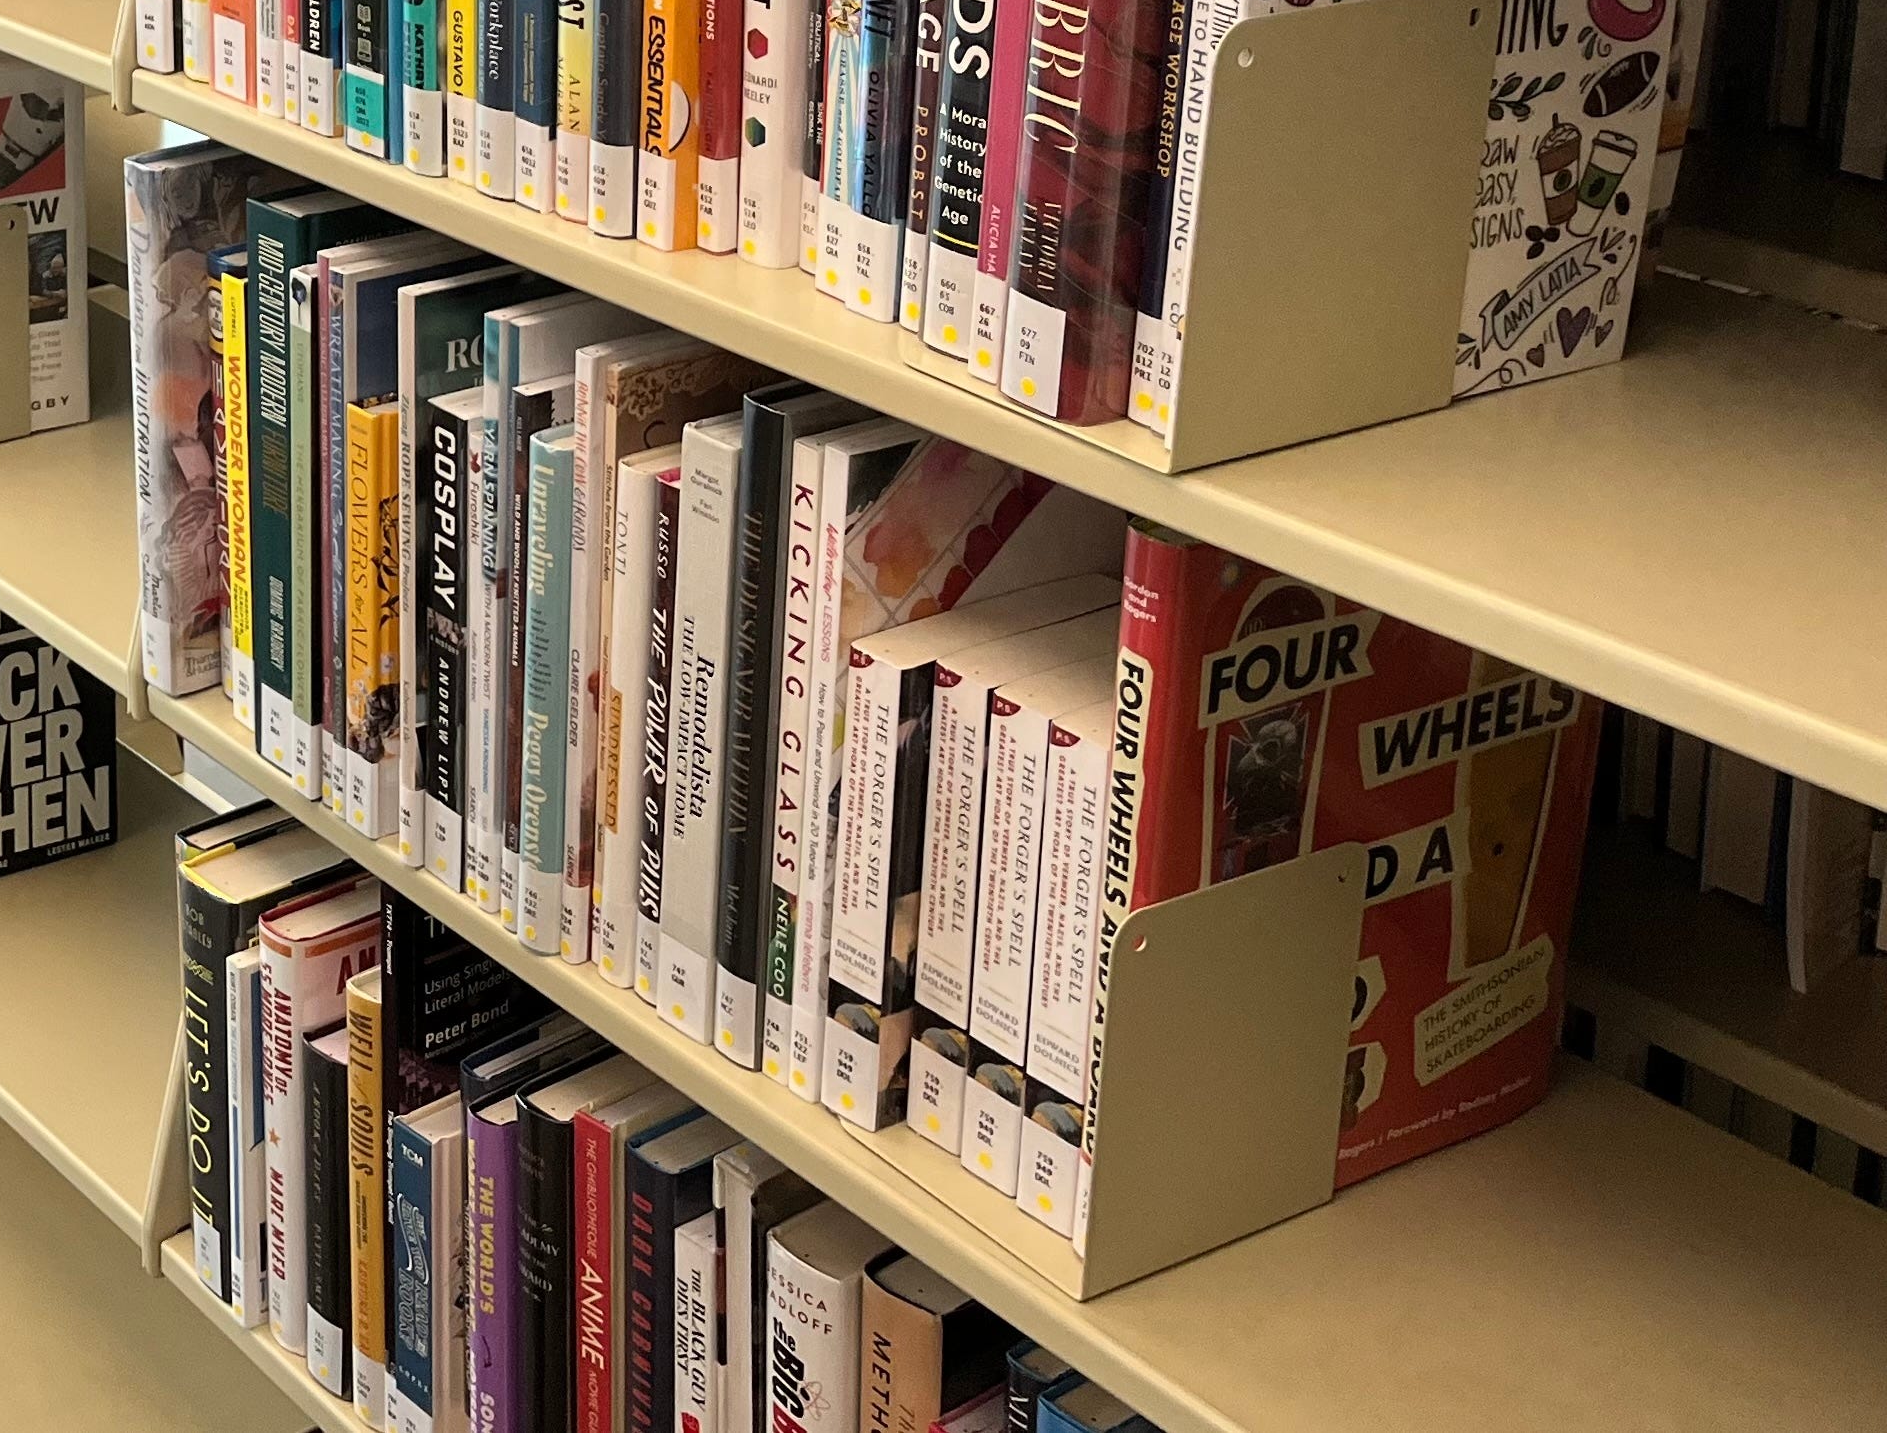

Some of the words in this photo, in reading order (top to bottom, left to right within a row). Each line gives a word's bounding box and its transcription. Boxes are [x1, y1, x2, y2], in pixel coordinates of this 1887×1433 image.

[258, 234, 285, 350] MID-CENTURY
[228, 354, 244, 472] WONDER
[259, 352, 286, 428] MODERN
[230, 474, 245, 584] WOMAN
[348, 441, 370, 589] FLOWERS
[432, 426, 456, 611] COSPLAY
[529, 464, 555, 598] Unraveling
[616, 511, 629, 575] TONTI
[652, 606, 668, 669] THE
[782, 483, 818, 701] KICKING
[1115, 659, 1144, 759] FOUR
[1206, 623, 1360, 714] FOUR
[642, 675, 668, 787] POWER
[687, 655, 716, 818] Remodelista
[875, 704, 890, 746] THE
[1373, 675, 1575, 777] WHEELS
[643, 797, 660, 834] OF
[774, 731, 804, 873] GLASS
[869, 749, 888, 849] FORGER'S
[1102, 769, 1137, 909] WHEELS
[864, 851, 881, 912] SPELL
[186, 986, 210, 1093] LET'S
[425, 1020, 465, 1048] Peter
[471, 999, 509, 1026] Bond
[188, 1101, 213, 1172] DO
[580, 1260, 606, 1370] ANIME
